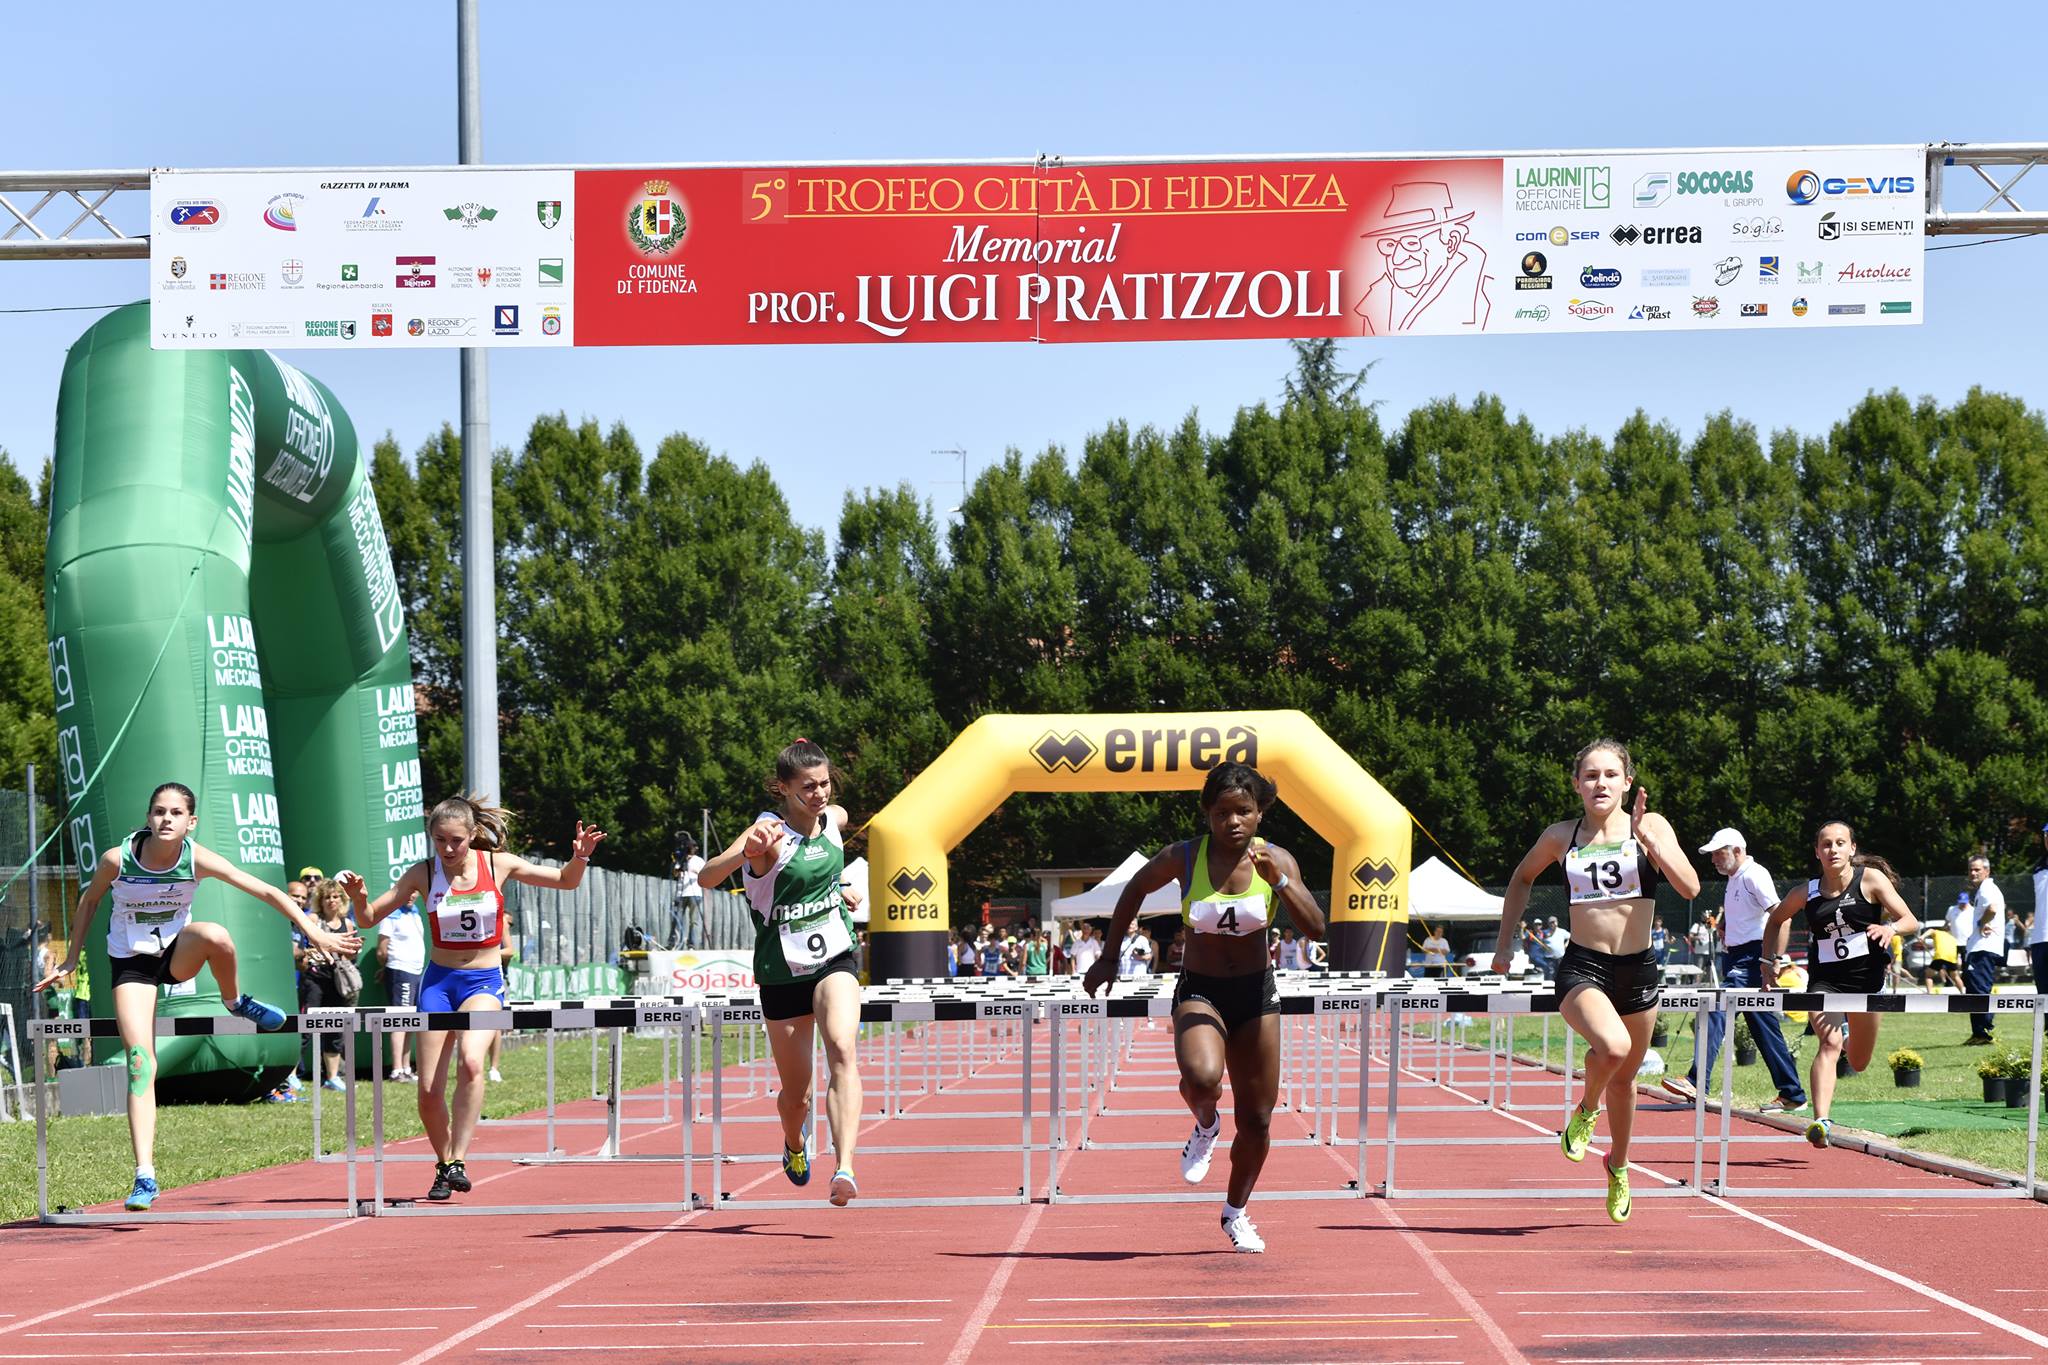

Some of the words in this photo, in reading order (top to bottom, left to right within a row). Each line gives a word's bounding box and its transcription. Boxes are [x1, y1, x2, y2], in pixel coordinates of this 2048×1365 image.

[1516, 167, 1582, 188] LAURINI
[1676, 170, 1754, 195] SOCOGAS
[320, 182, 366, 190] GAZZETTA
[379, 181, 410, 189] PARMA
[1822, 176, 1915, 195] GEVIS
[797, 178, 965, 213] TROFEO
[973, 170, 1100, 213] CITTÀ
[1108, 176, 1153, 211] DI
[1164, 173, 1349, 209] FIDENZA
[1516, 188, 1582, 200] OFFICINE
[1515, 200, 1582, 212] MECCANICHE
[1723, 199, 1731, 208] IL
[1732, 197, 1764, 207] GRUPPO
[1842, 221, 1858, 232] ISI
[1860, 220, 1914, 231] SEMENTI
[942, 222, 1122, 263] Memorial
[628, 264, 686, 279] COMUNE
[1837, 262, 1912, 283] Autoluce
[227, 273, 266, 282] REGIONE
[1581, 272, 1620, 283] Melinda
[227, 281, 267, 291] PIEMONTE
[316, 282, 384, 292] RegioneLombardia
[617, 280, 633, 294] DI
[638, 279, 698, 294] FIDENZA
[747, 291, 846, 324] PROF.
[855, 272, 1000, 337] LUIGI
[1016, 269, 1344, 323] PRATIZZOLI
[1568, 304, 1614, 317] Sojasun
[1647, 310, 1671, 321] plast
[304, 321, 339, 329] REGIONE
[306, 329, 339, 337] MARCHE
[347, 495, 387, 610] MECCANICHE
[1583, 860, 1623, 891] 13
[460, 909, 477, 931] 5
[1216, 906, 1240, 932] 4
[806, 933, 828, 960] 9
[1833, 938, 1850, 960] 6
[672, 969, 760, 992] Sojasu
[1322, 1000, 1360, 1010] BERG
[1401, 999, 1439, 1009] BERG
[1661, 998, 1698, 1008] BERG
[1737, 997, 1775, 1007] BERG
[1996, 999, 2034, 1009] BERG
[984, 1006, 1022, 1015] BERG
[1061, 1004, 1099, 1014] BERG
[644, 1012, 682, 1022] BERG
[723, 1011, 761, 1021] BERG
[306, 1019, 343, 1028] BERG
[383, 1018, 420, 1027] BERG
[44, 1024, 82, 1035] BERG
